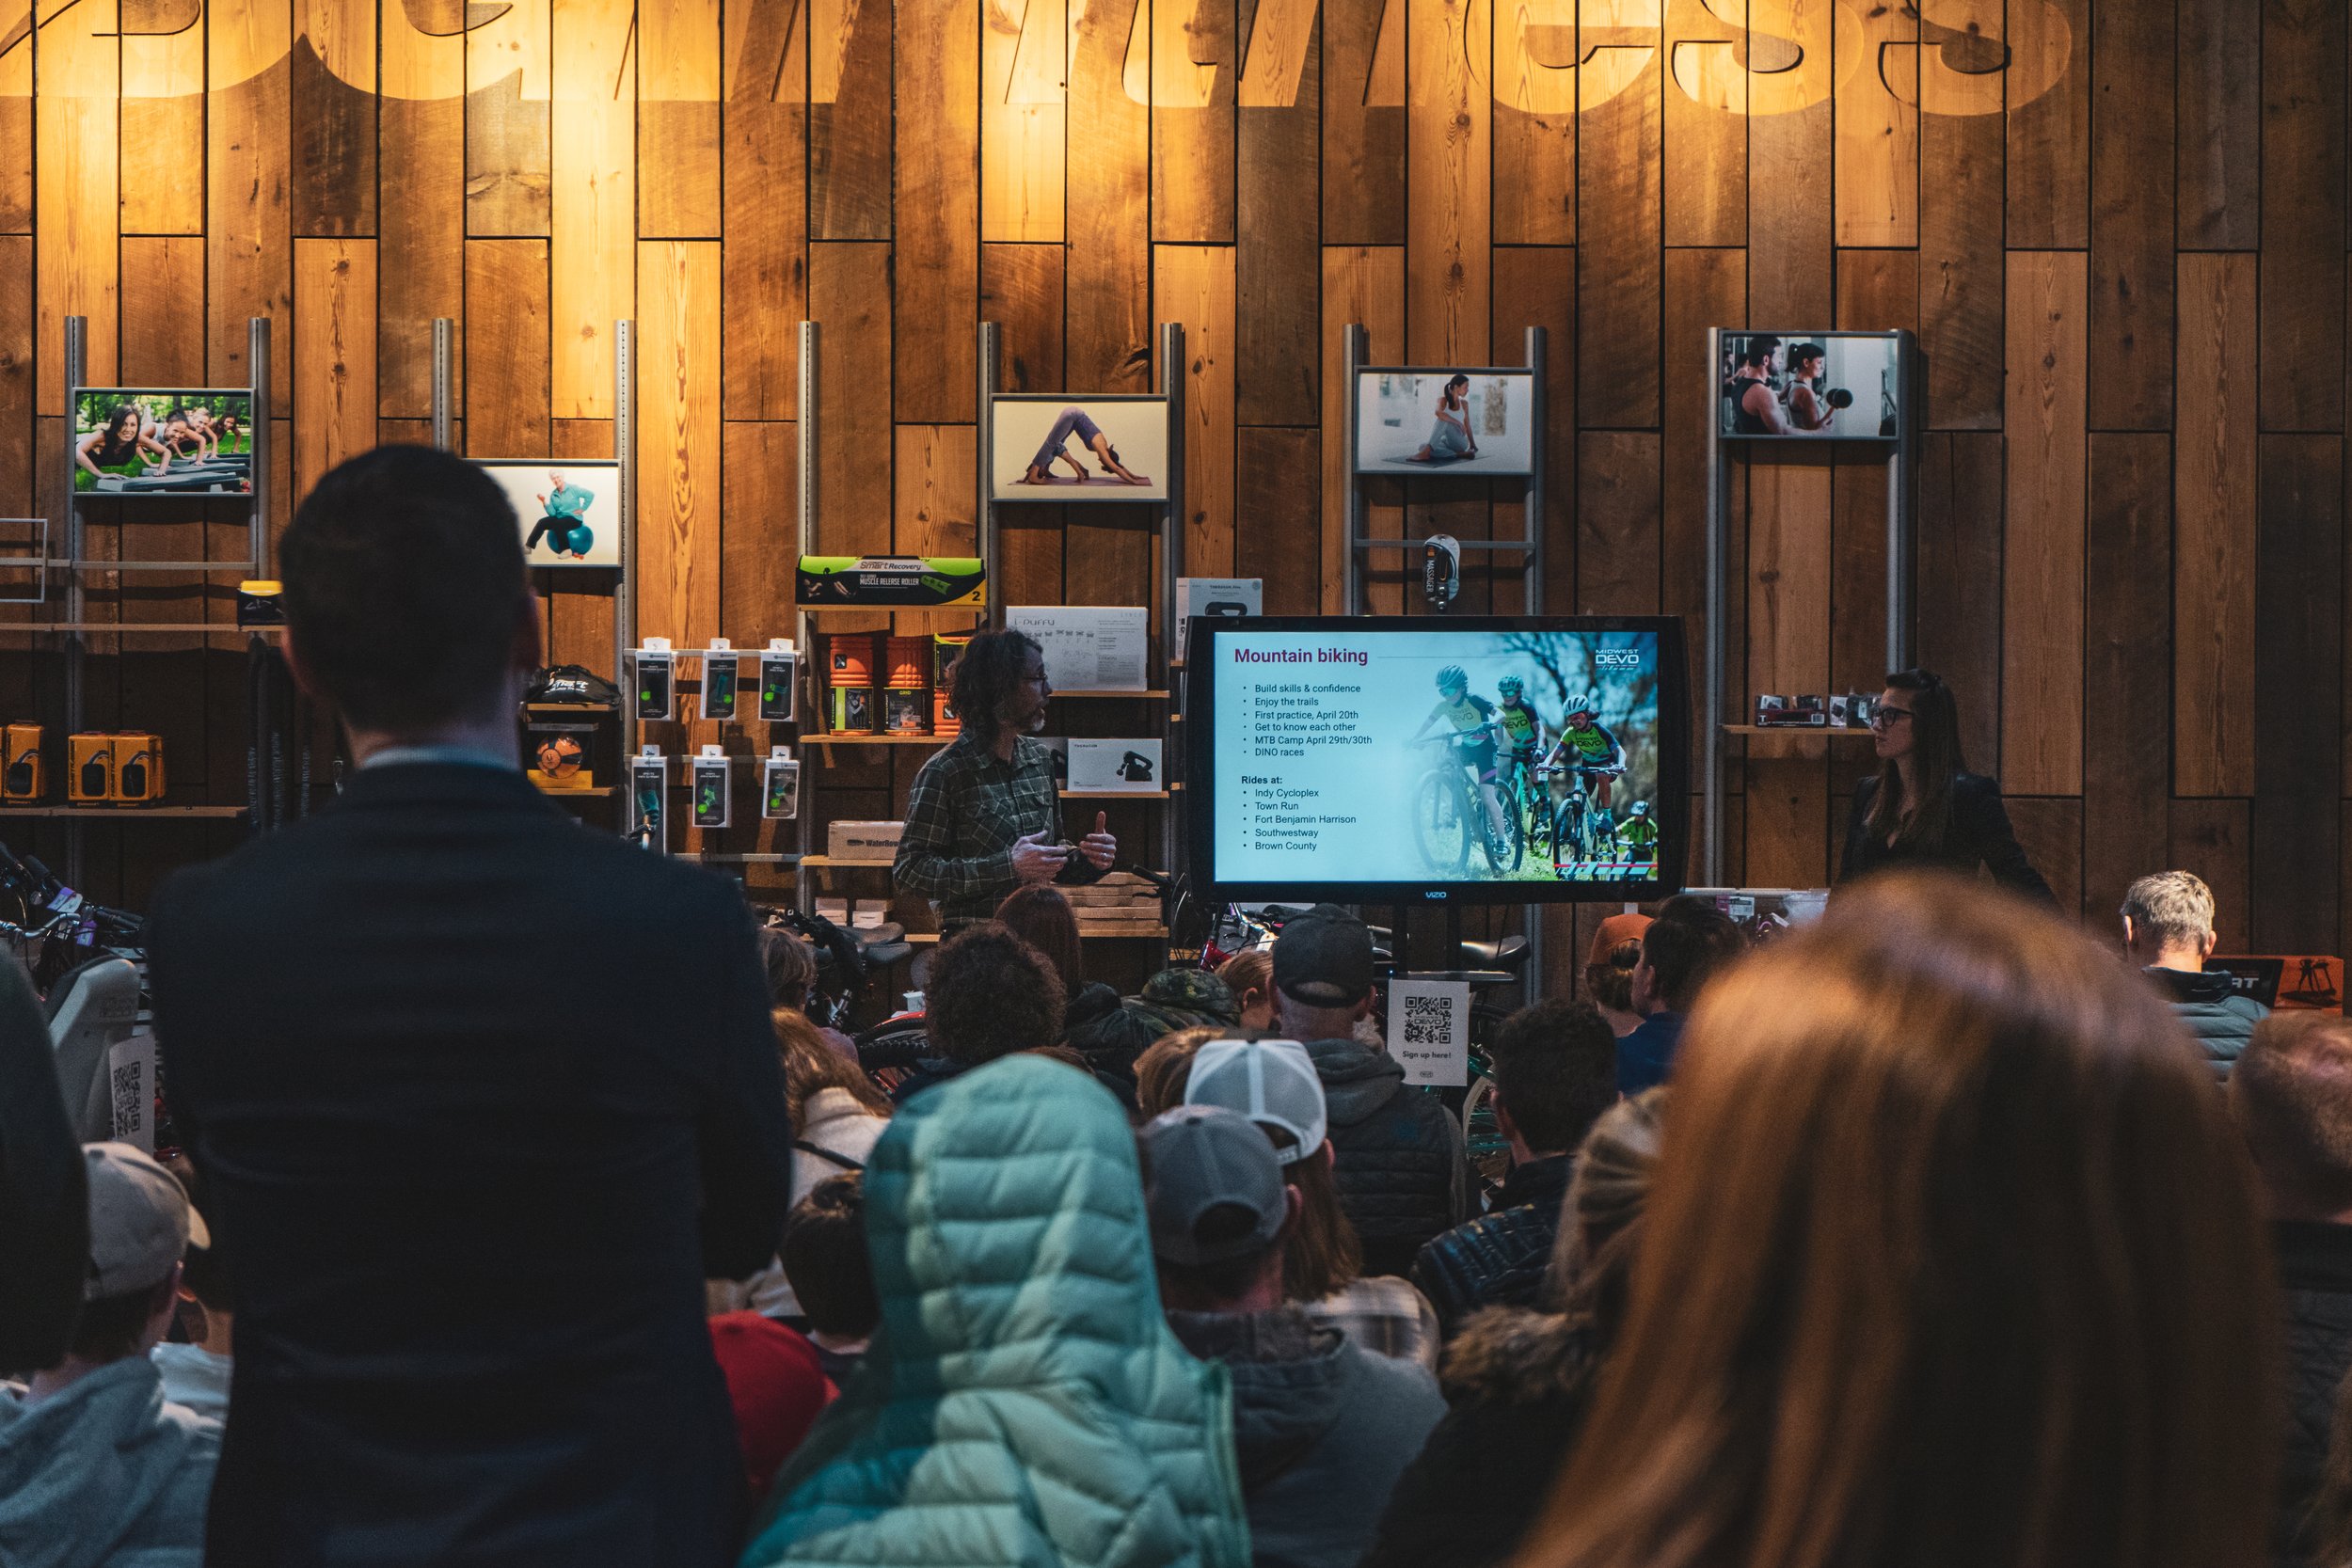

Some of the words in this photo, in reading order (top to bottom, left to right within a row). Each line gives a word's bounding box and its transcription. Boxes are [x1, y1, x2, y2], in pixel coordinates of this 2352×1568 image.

[1425, 560, 1435, 593] MASSAGER
[1234, 648, 1312, 663] Mountain
[1318, 648, 1368, 666] biking
[1596, 655, 1639, 664] DEVO
[1255, 684, 1277, 692] Build
[1279, 684, 1301, 692] skills
[1304, 684, 1311, 692] &
[1312, 684, 1361, 692] confidence
[1255, 698, 1279, 707] Enjoy
[1255, 711, 1275, 720] First
[1277, 711, 1314, 721] practice,
[1316, 711, 1337, 721] April
[1339, 711, 1359, 720] 20th
[1255, 722, 1270, 731] Get
[1273, 722, 1281, 731] to
[1284, 722, 1307, 731] know
[1310, 722, 1330, 731] each
[1333, 722, 1356, 731] other
[1255, 736, 1276, 744] MTB
[1278, 736, 1304, 746] Camp
[1306, 736, 1327, 746] April
[1328, 736, 1372, 744] 29th/30th
[1255, 748, 1278, 756] DINO
[1241, 776, 1268, 784] Rides
[1271, 776, 1282, 784] at:
[1255, 788, 1274, 799] Indy
[1277, 788, 1319, 799] Cycloplex
[1255, 816, 1273, 824] Fort
[1276, 816, 1316, 825] Benjamin
[1319, 816, 1357, 824] Harrison
[1255, 829, 1319, 838] Southwestway
[1255, 842, 1282, 850] Brown
[1285, 842, 1317, 851] County
